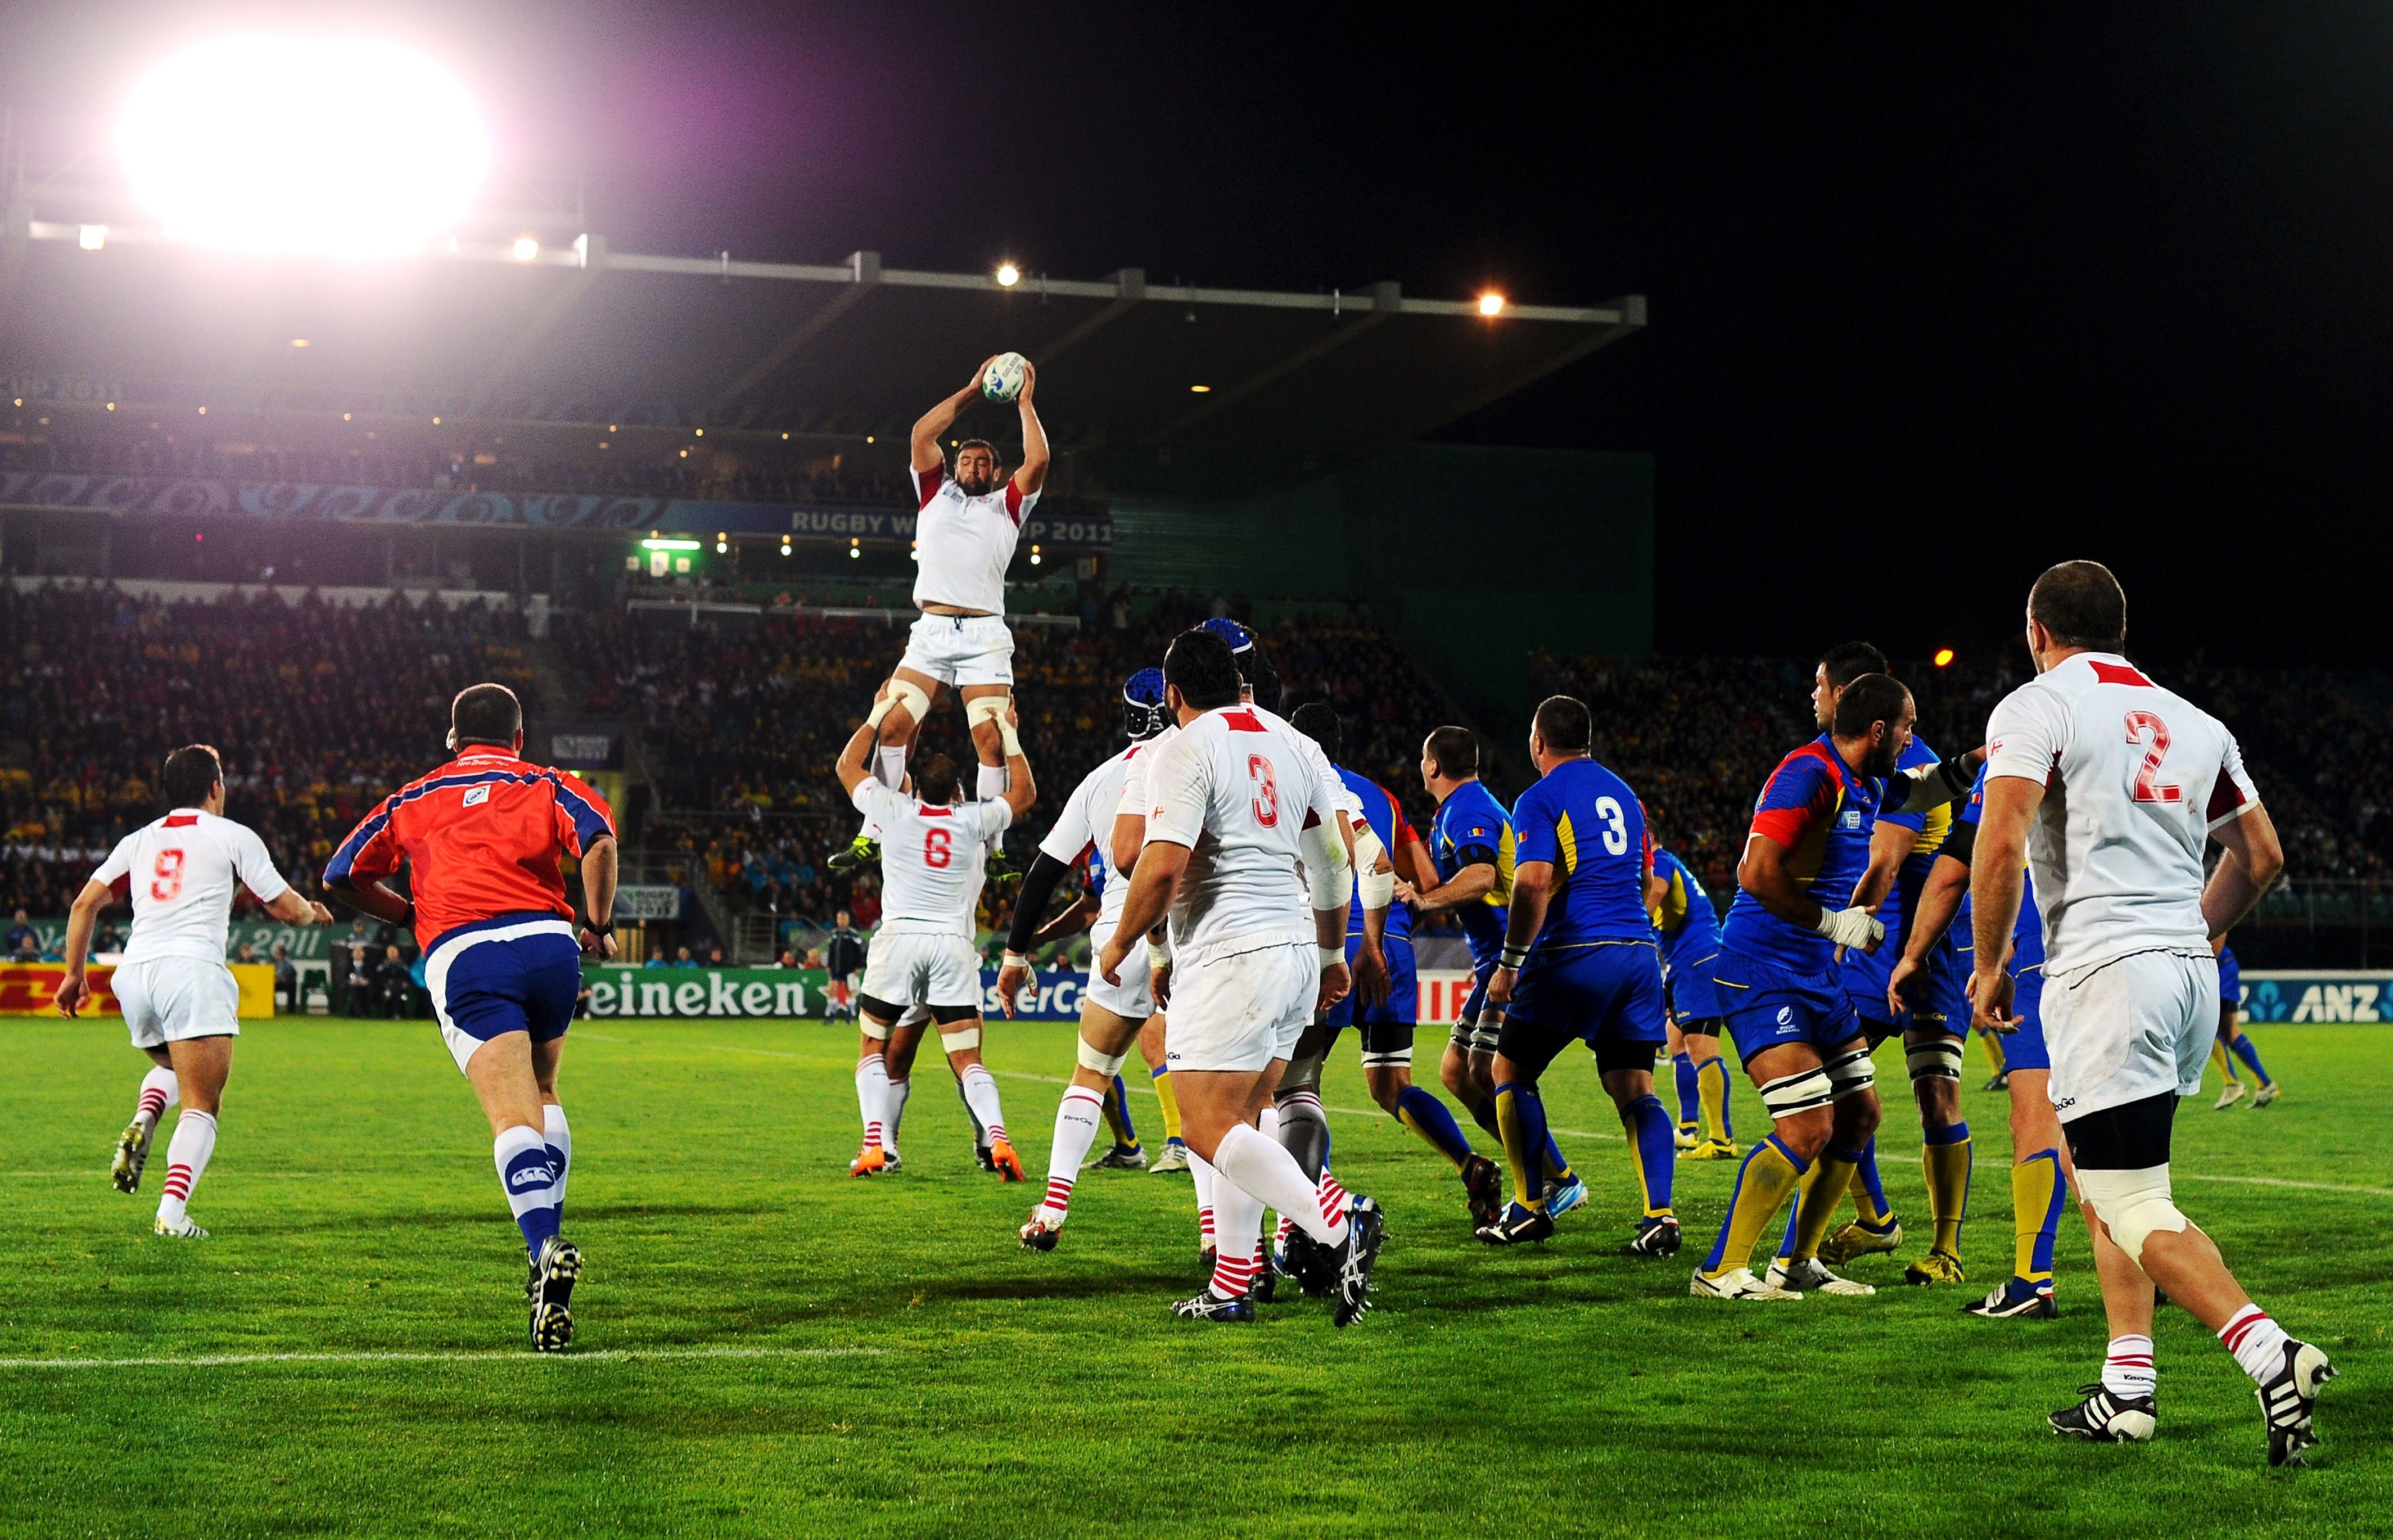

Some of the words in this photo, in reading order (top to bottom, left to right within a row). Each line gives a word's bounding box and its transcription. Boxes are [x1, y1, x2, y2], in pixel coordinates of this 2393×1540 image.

[792, 512, 883, 534] RUGBY
[1053, 522, 1112, 541] 2011
[2124, 711, 2183, 802] 2
[1248, 753, 1278, 828] 3
[1596, 796, 1627, 855] 3
[924, 828, 951, 869] 6
[150, 848, 186, 902] 9
[251, 928, 321, 957] 2011
[589, 971, 808, 1015] eineken
[2292, 985, 2380, 1023] ANZ
